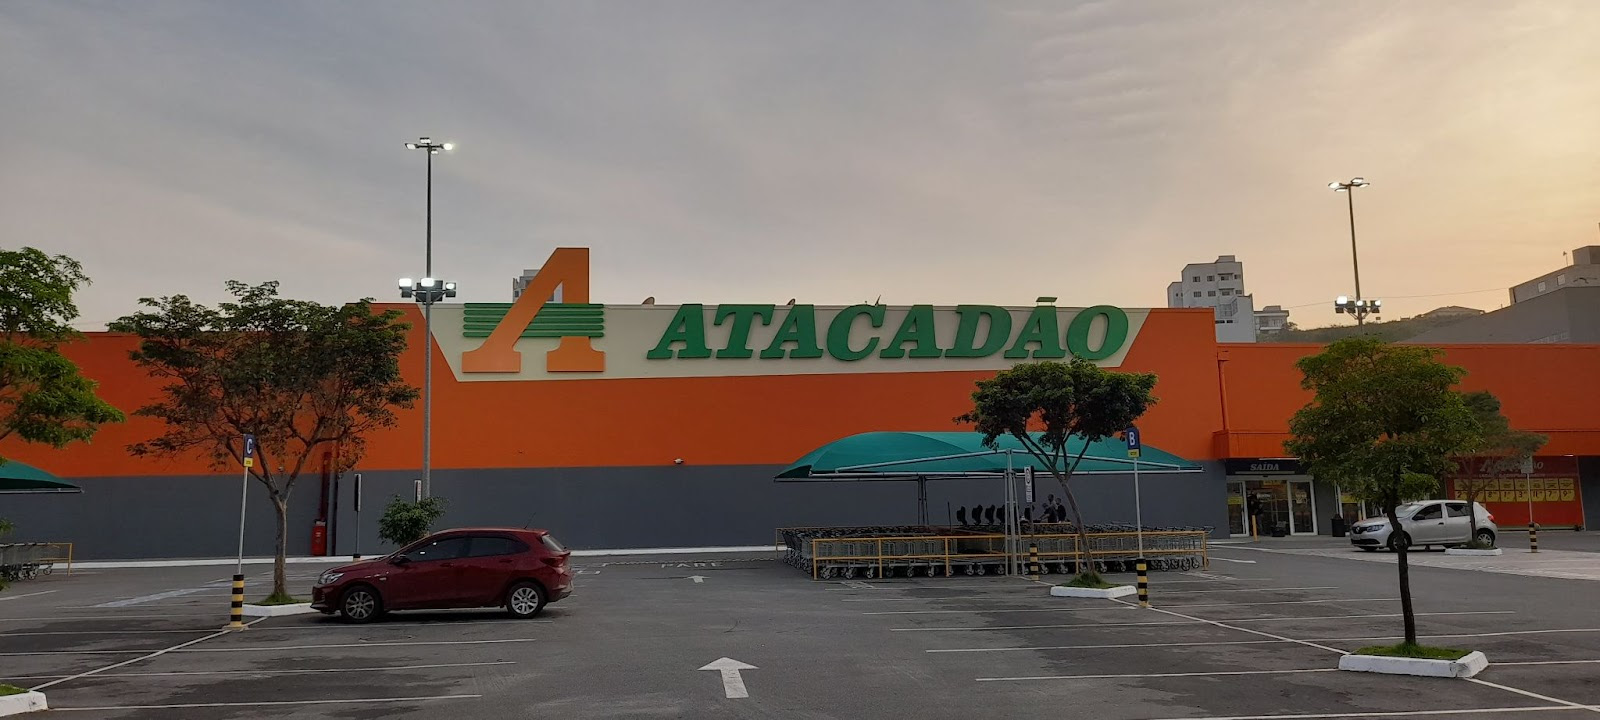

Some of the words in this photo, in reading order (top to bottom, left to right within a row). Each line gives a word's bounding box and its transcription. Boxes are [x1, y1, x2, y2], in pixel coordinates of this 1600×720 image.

[647, 296, 1129, 362] ATACADÃO
[246, 438, 253, 454] C
[1129, 431, 1136, 446] B
[1250, 462, 1280, 471] SAÍDA
